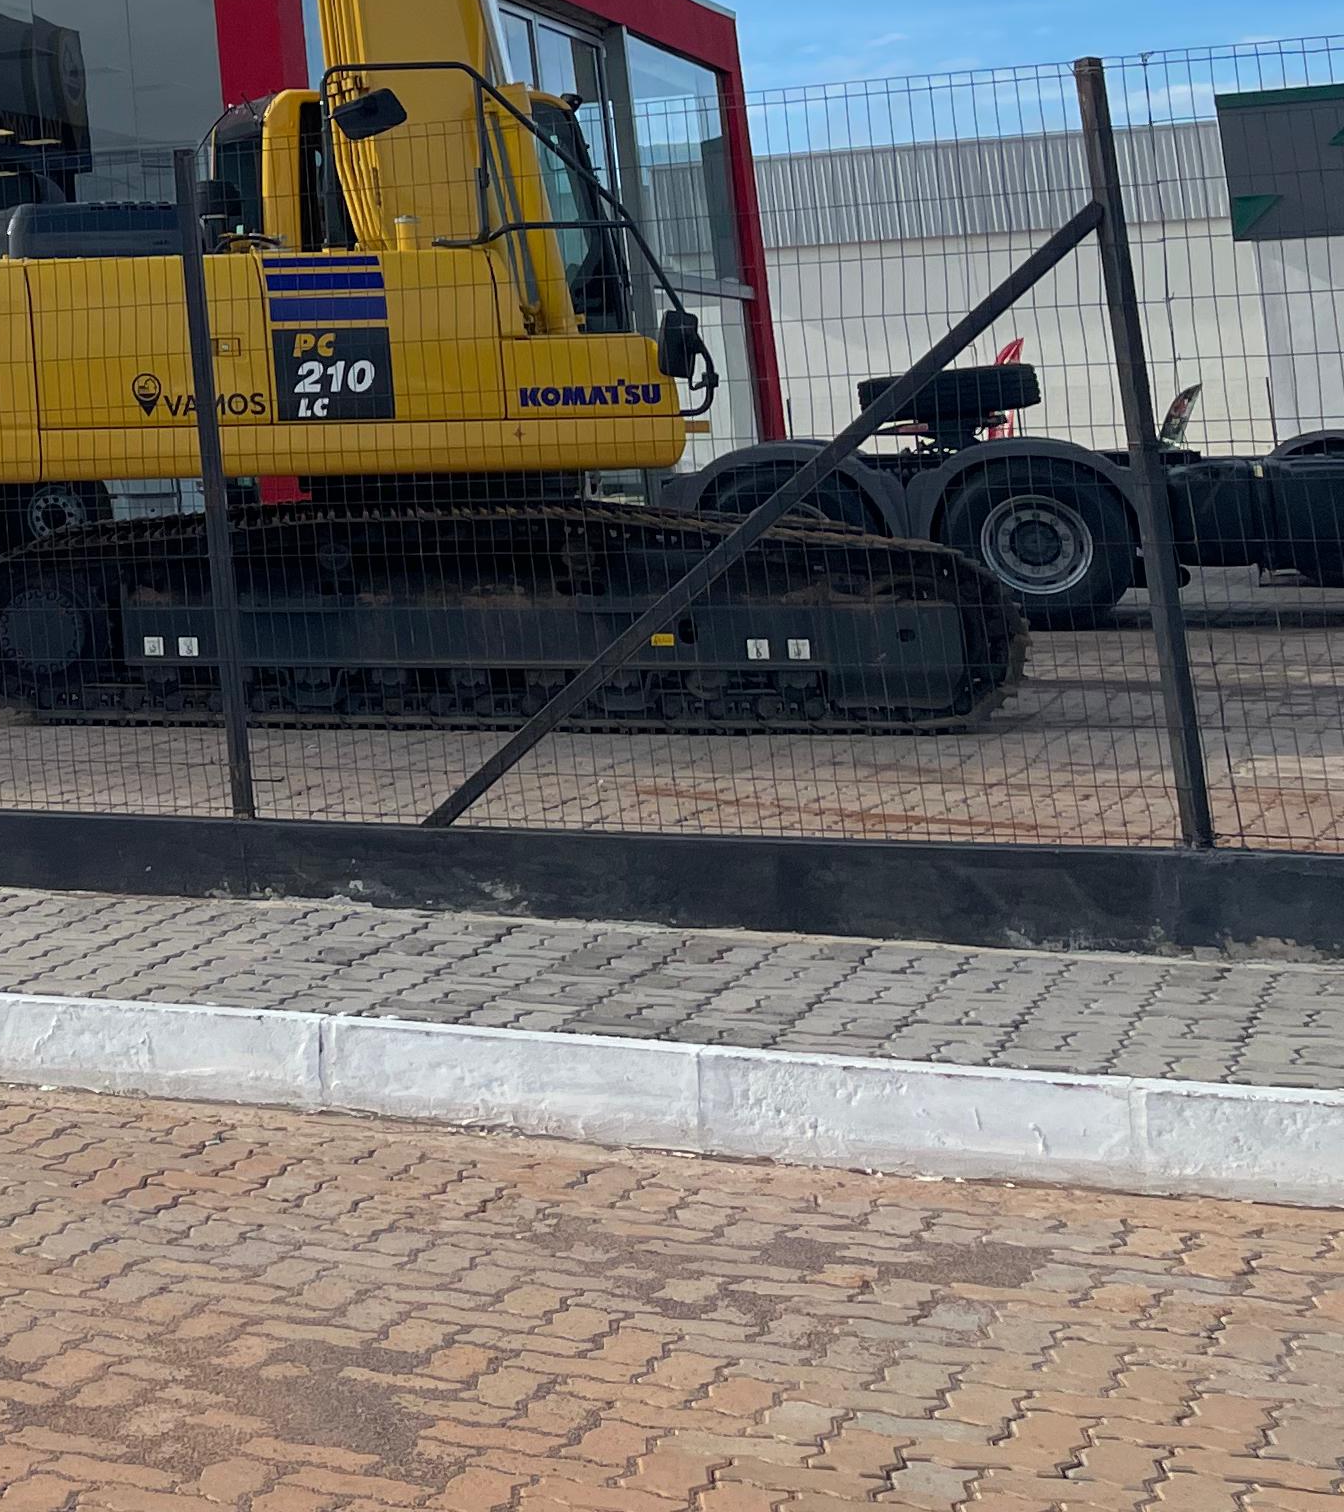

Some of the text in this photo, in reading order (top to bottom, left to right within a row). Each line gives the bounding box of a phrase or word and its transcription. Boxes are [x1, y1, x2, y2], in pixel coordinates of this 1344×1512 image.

[293, 333, 334, 357] PC
[294, 360, 376, 394] 210
[519, 378, 661, 408] KOMATSU
[298, 396, 329, 418] LC
